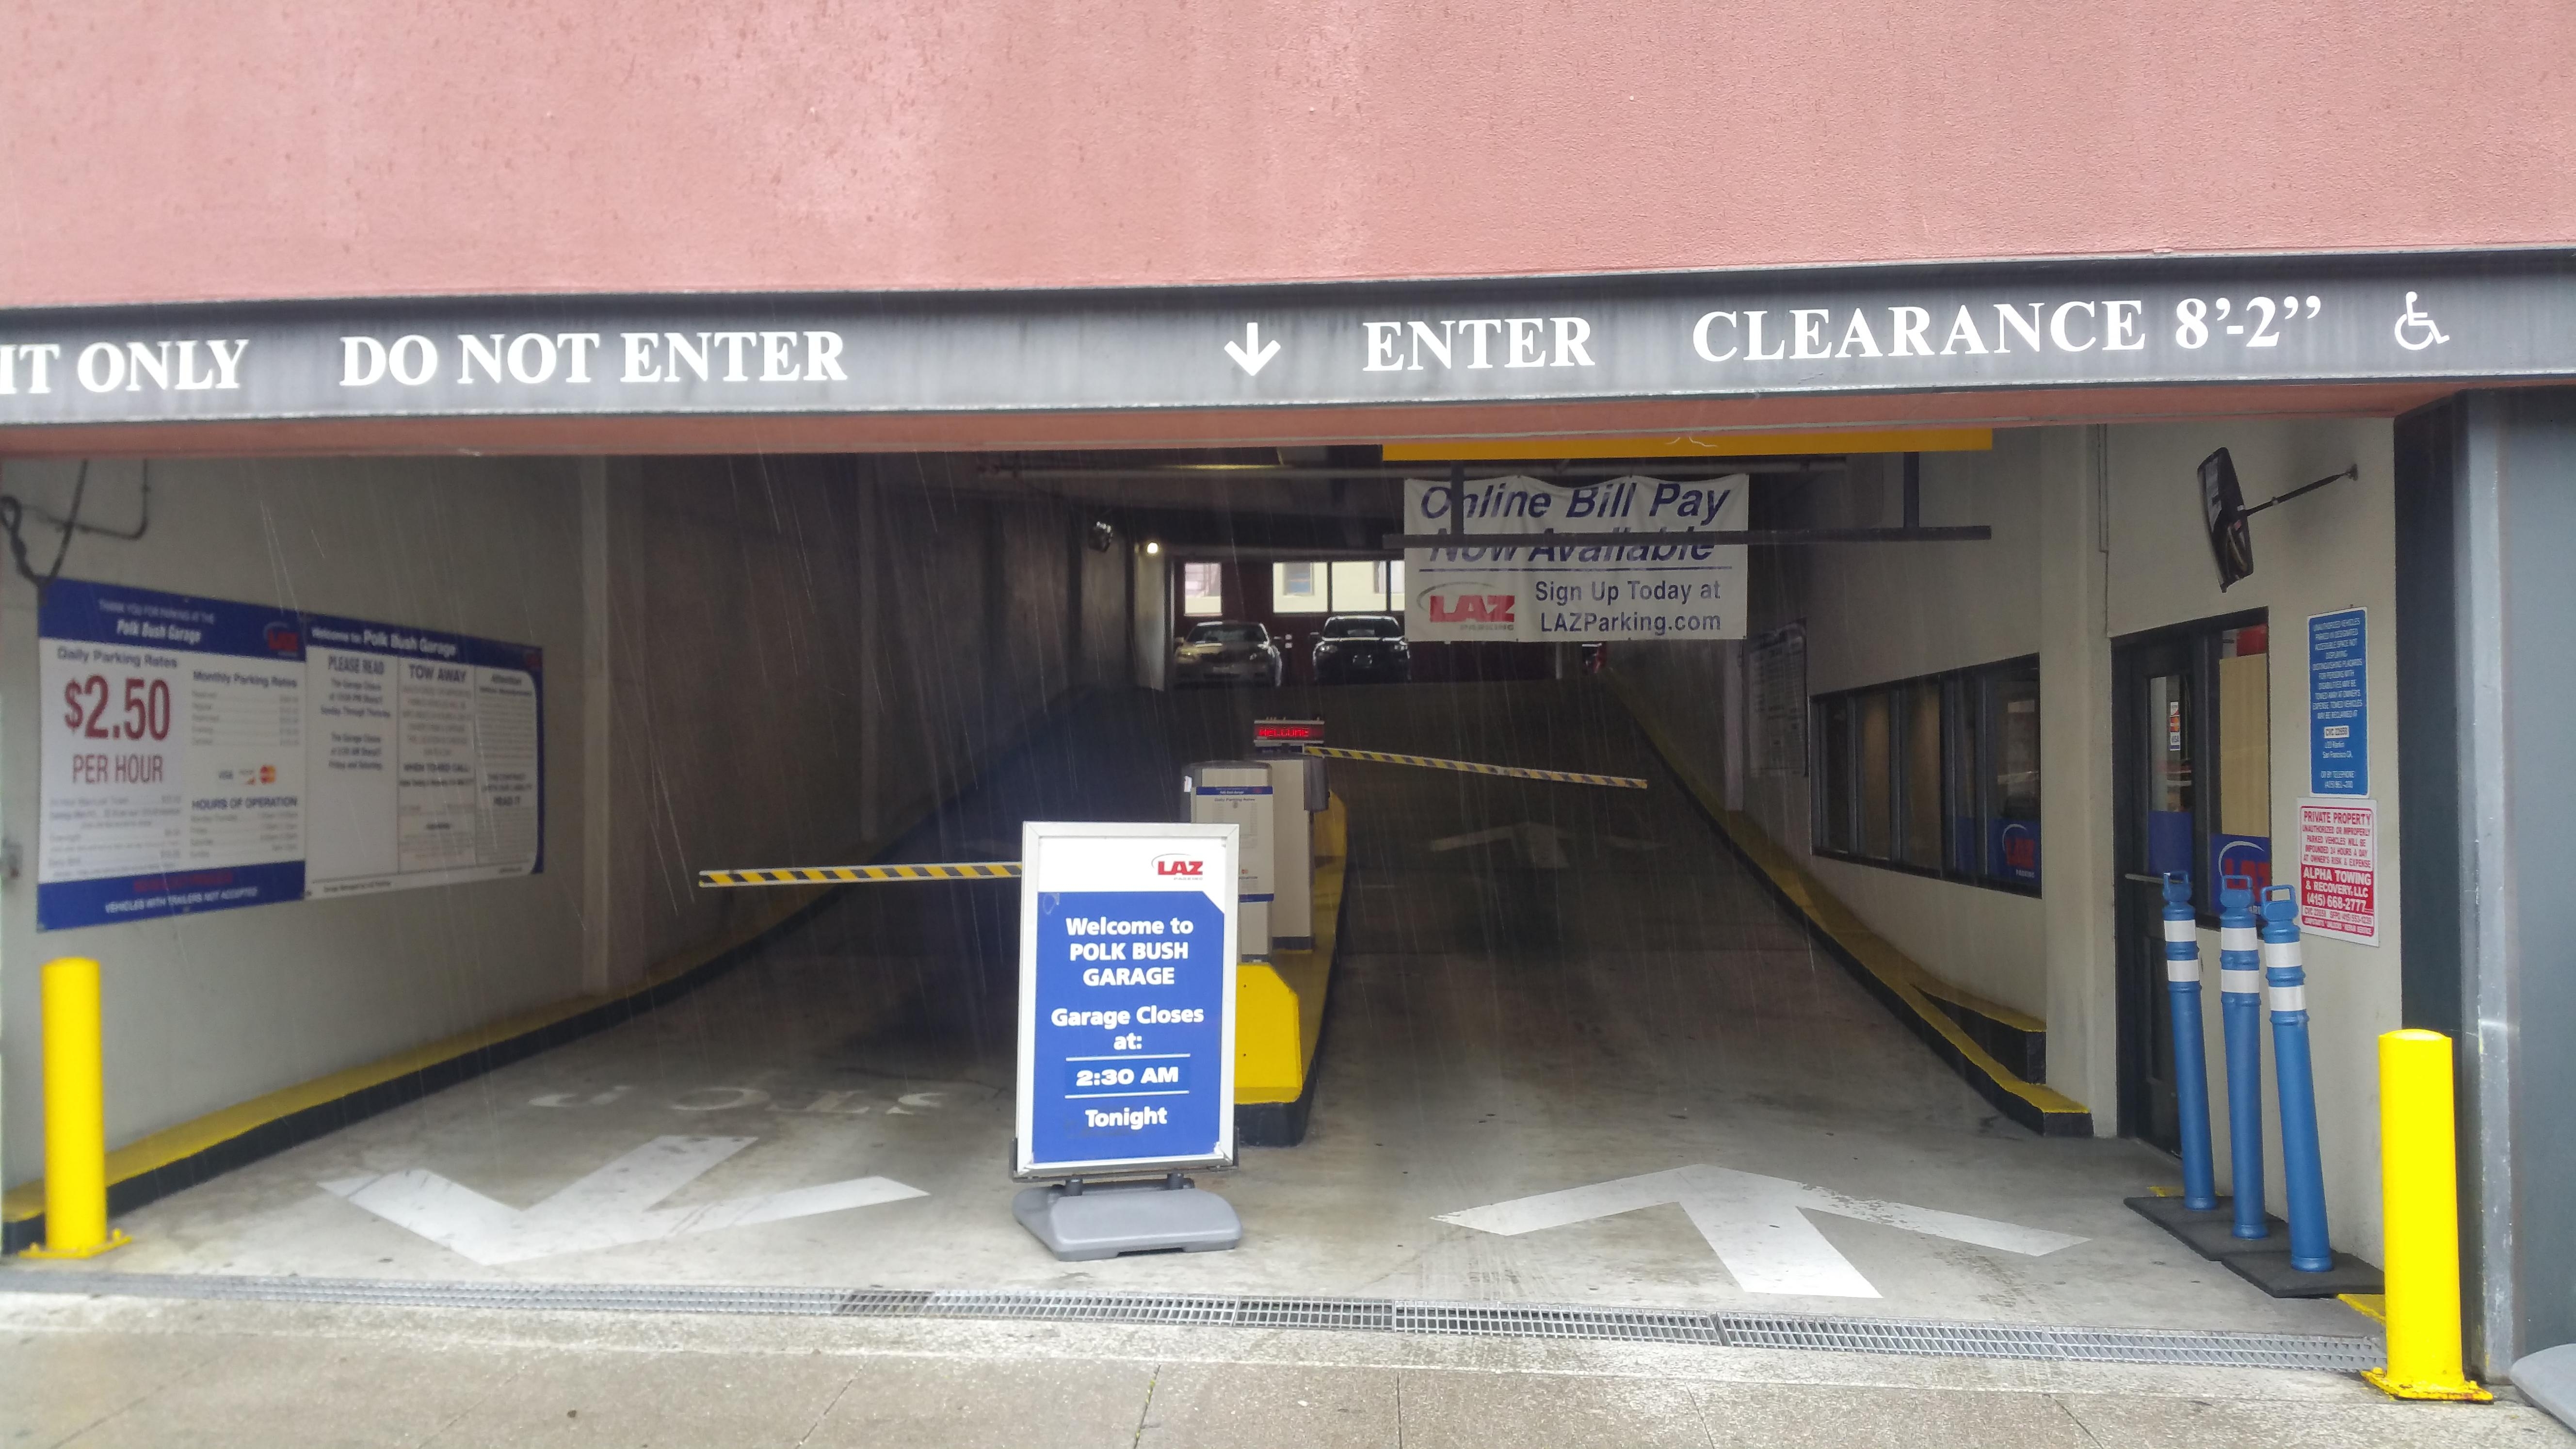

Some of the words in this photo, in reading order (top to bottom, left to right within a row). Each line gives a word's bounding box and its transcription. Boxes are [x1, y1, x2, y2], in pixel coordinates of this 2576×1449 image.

[1692, 300, 2146, 363] CLEARANCE
[1362, 317, 1596, 372] ENTER
[77, 339, 248, 394] ONLY
[339, 335, 438, 387] DO
[456, 333, 600, 385] NOT
[619, 331, 849, 384] ENTER
[1421, 483, 1551, 518] Online
[1566, 483, 1637, 518] Bill
[1650, 483, 1730, 526] Pay
[1535, 581, 1582, 606] Sign
[1592, 581, 1619, 605] Up
[1627, 580, 1692, 605] Today
[1700, 581, 1721, 599] at
[1430, 595, 1514, 622] LAZ
[117, 617, 139, 636] Polk
[142, 621, 165, 638] Bush
[168, 624, 202, 645] Garage
[1541, 612, 1721, 635] LAZParking.com
[58, 646, 89, 663] Daily
[93, 650, 141, 669] Parking
[144, 654, 177, 668] Rates
[328, 655, 359, 673] PLEASE
[409, 663, 434, 679] TOW
[437, 667, 466, 683] AWAY
[64, 675, 171, 741] $2.50
[72, 755, 109, 784] PER
[114, 755, 164, 784] HOUR
[192, 799, 228, 810] HOURS
[245, 796, 297, 808] OPERATION
[2304, 810, 2331, 823] PRIVATE
[2333, 812, 2371, 825] PROPERTY
[2325, 836, 2346, 845] VEHICLES
[1158, 861, 1203, 875] LAZ
[2303, 867, 2333, 881] ALPHA
[2334, 869, 2371, 886] TOWING
[2305, 880, 2312, 890] &
[2354, 886, 2369, 898] LLC
[2307, 892, 2325, 906] (415)
[2327, 895, 2367, 912] 668-2777
[1065, 917, 1165, 936] Welcome
[1170, 917, 1194, 934] to
[1070, 943, 1126, 962] POLK
[1132, 942, 1189, 960] BUSH
[1083, 967, 1175, 987] GARAGE
[1051, 1008, 1130, 1030] Garage
[1137, 1005, 1205, 1025] Closes
[1113, 1033, 1143, 1051] at:
[1076, 1069, 1134, 1087] 2:30
[1141, 1067, 1179, 1084] AM
[1085, 1106, 1168, 1130] Tonight
